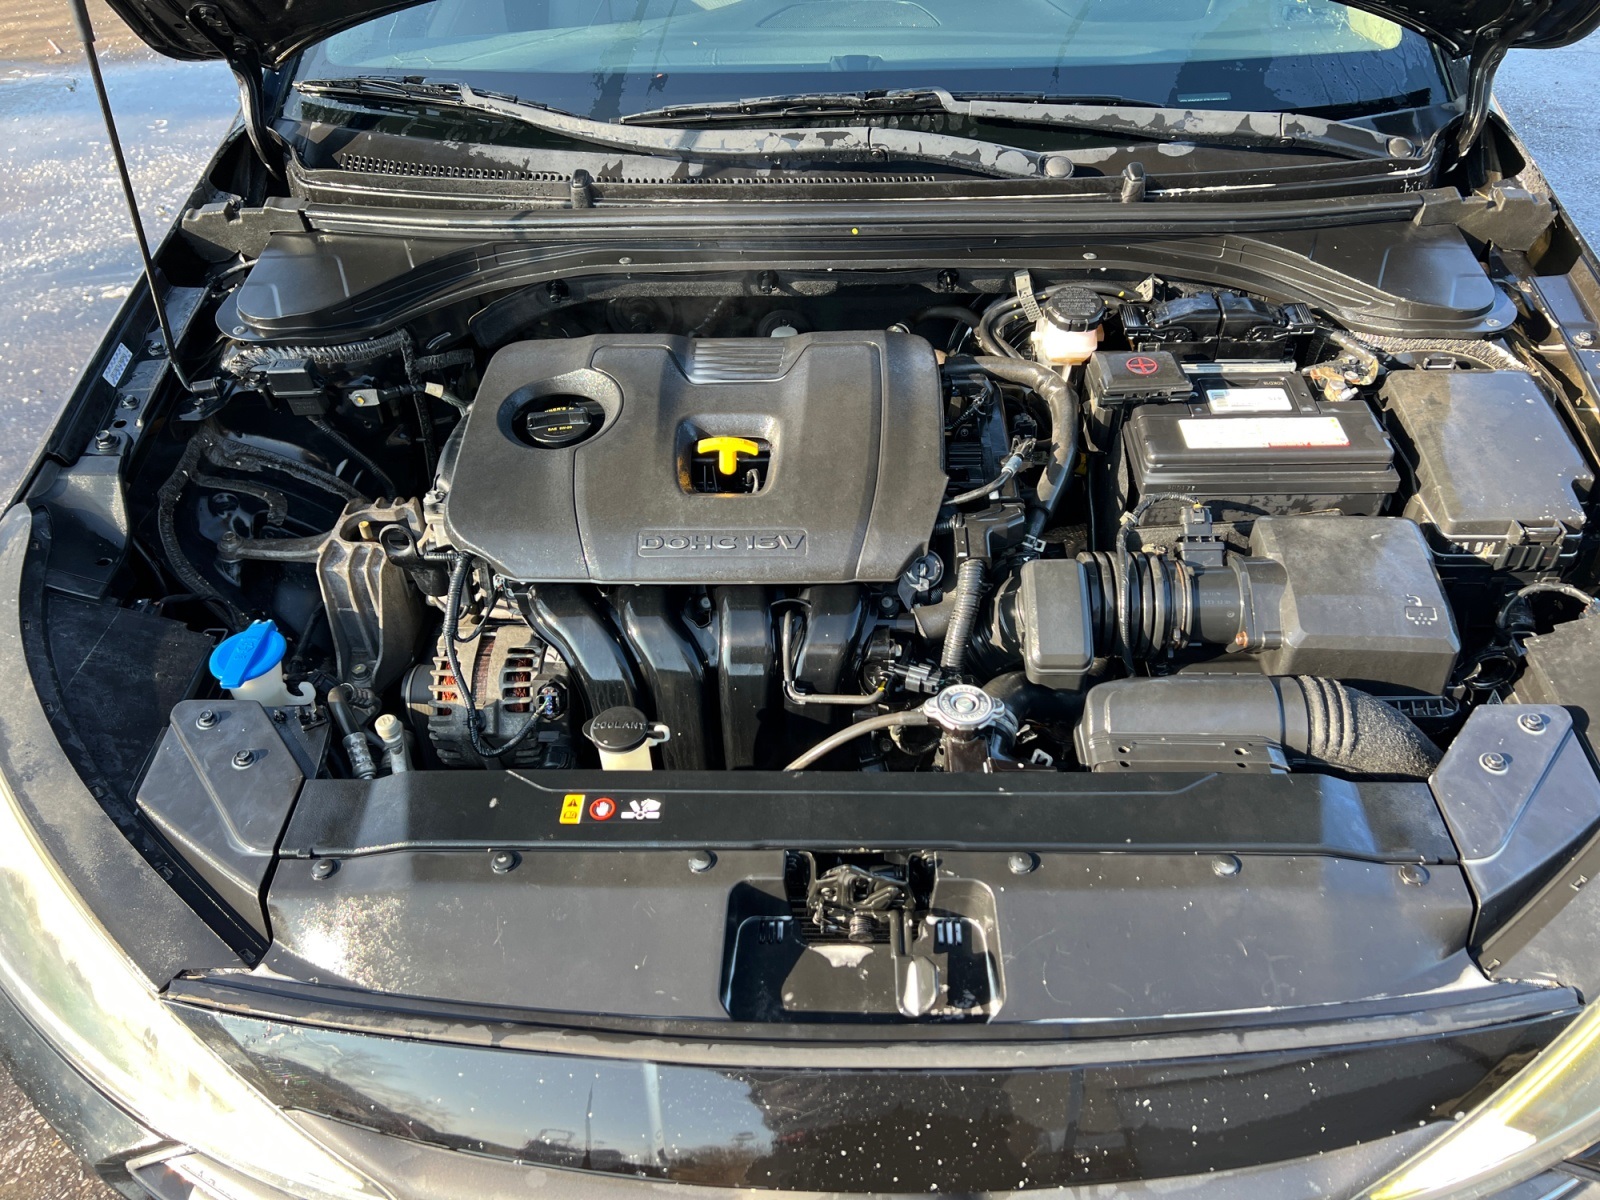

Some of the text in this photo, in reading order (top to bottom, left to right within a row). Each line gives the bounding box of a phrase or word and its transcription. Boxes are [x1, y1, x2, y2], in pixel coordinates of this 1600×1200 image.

[641, 535, 805, 550] DOHC 16V
[593, 721, 646, 730] COOLANT
